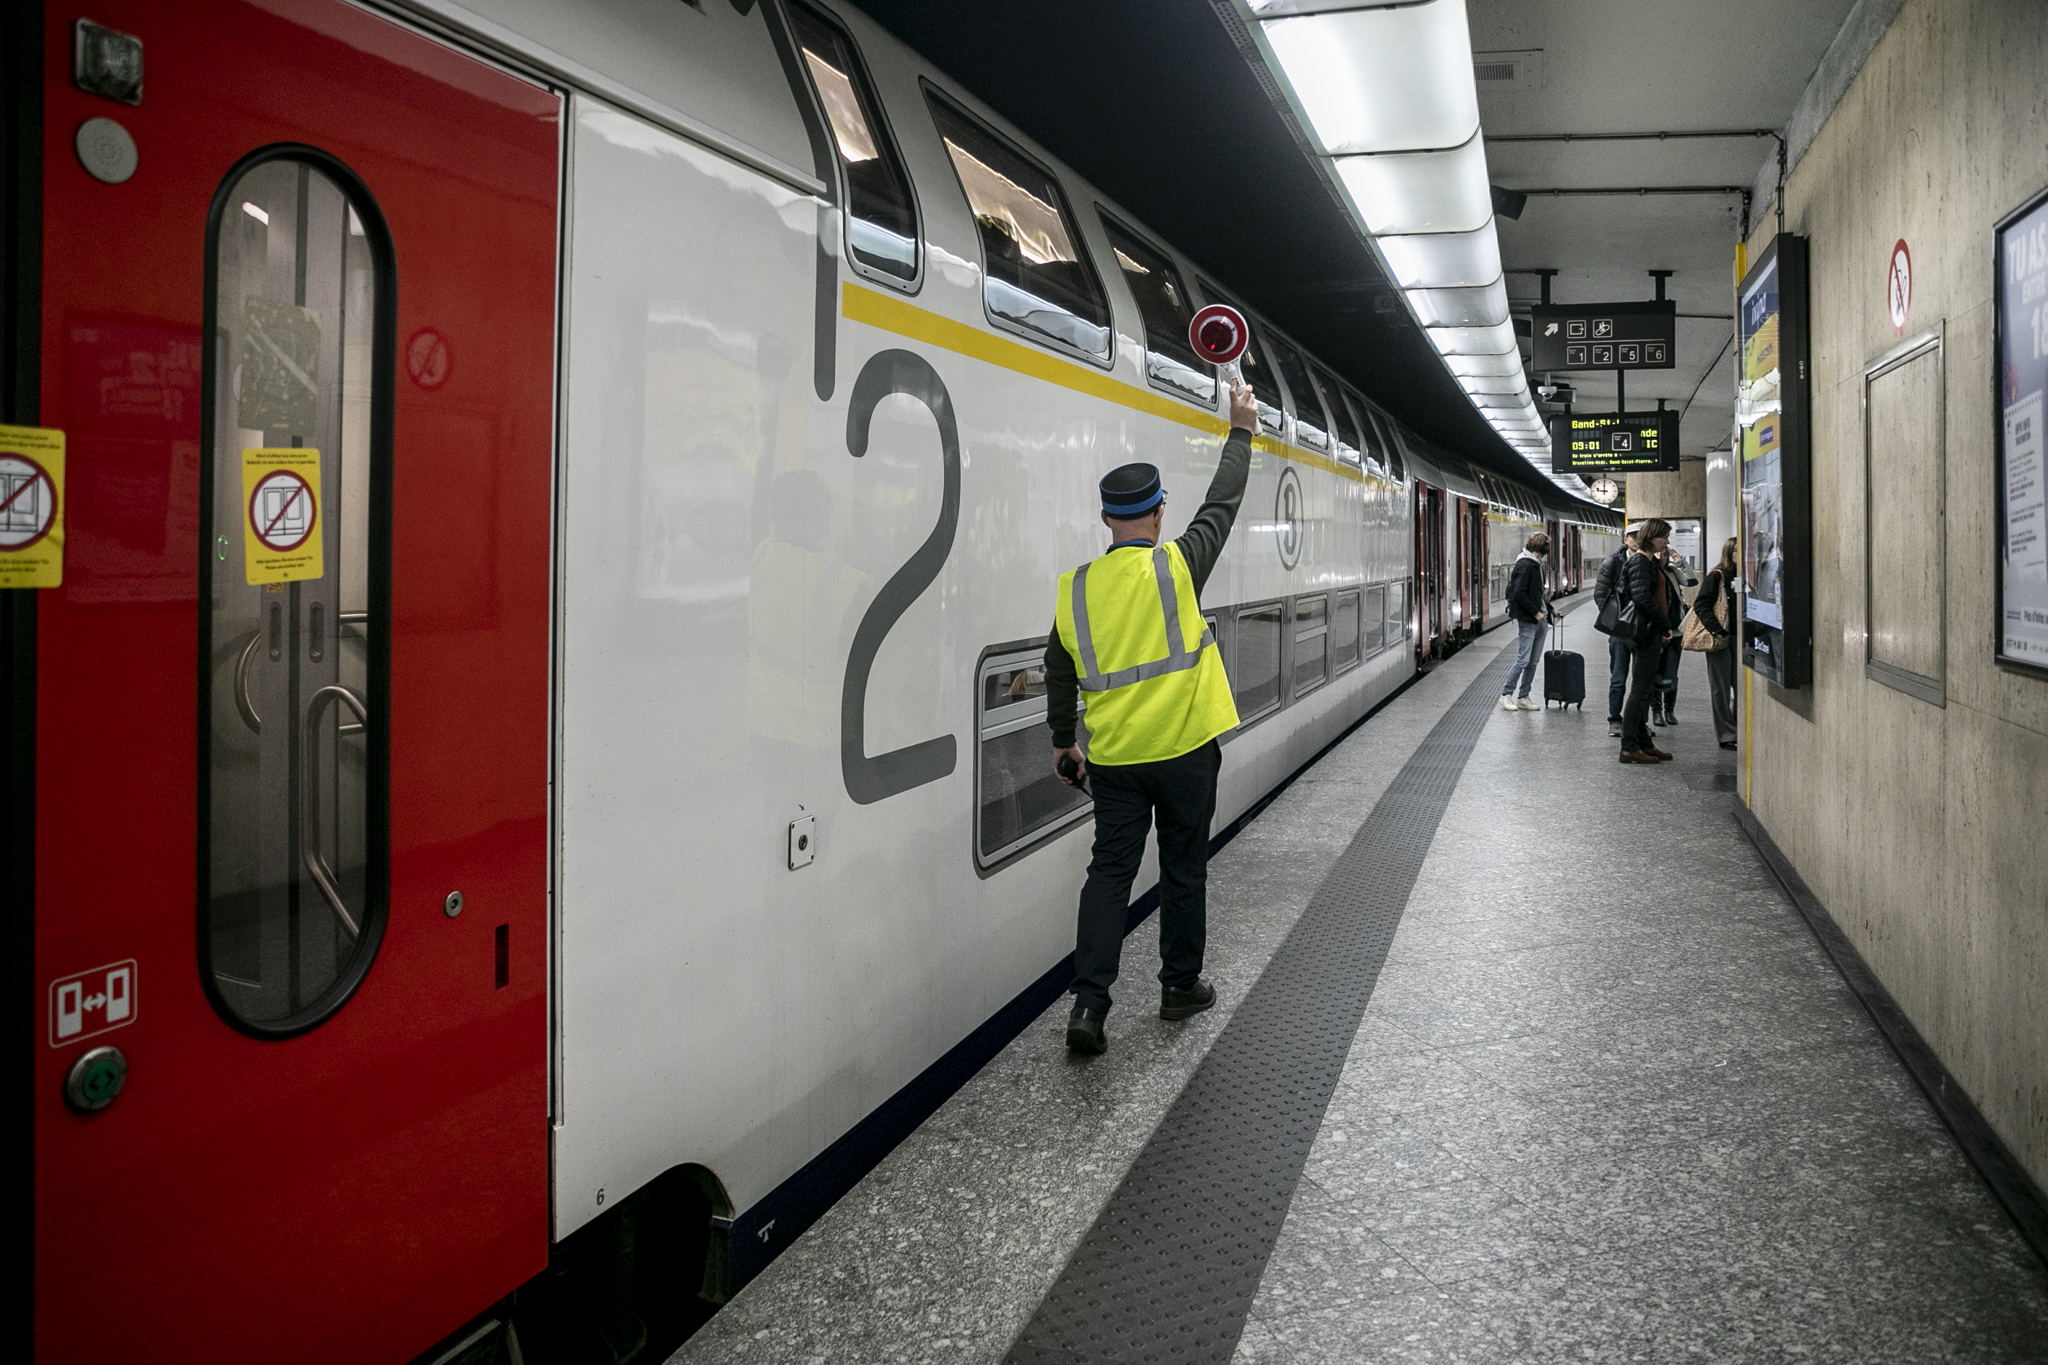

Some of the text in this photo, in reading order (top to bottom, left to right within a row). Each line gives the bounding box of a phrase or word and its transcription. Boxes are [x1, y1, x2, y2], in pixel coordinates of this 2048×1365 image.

[2008, 221, 2047, 285] TU AS
[1579, 352, 1584, 362] 1
[1603, 351, 1610, 361] 2
[1629, 350, 1636, 360] 5
[1655, 350, 1662, 360] 6
[1572, 441, 1600, 451] 09:01
[1622, 439, 1628, 448] 4
[1646, 439, 1658, 449] IC
[841, 348, 961, 804] 2
[596, 1188, 605, 1206] 6
